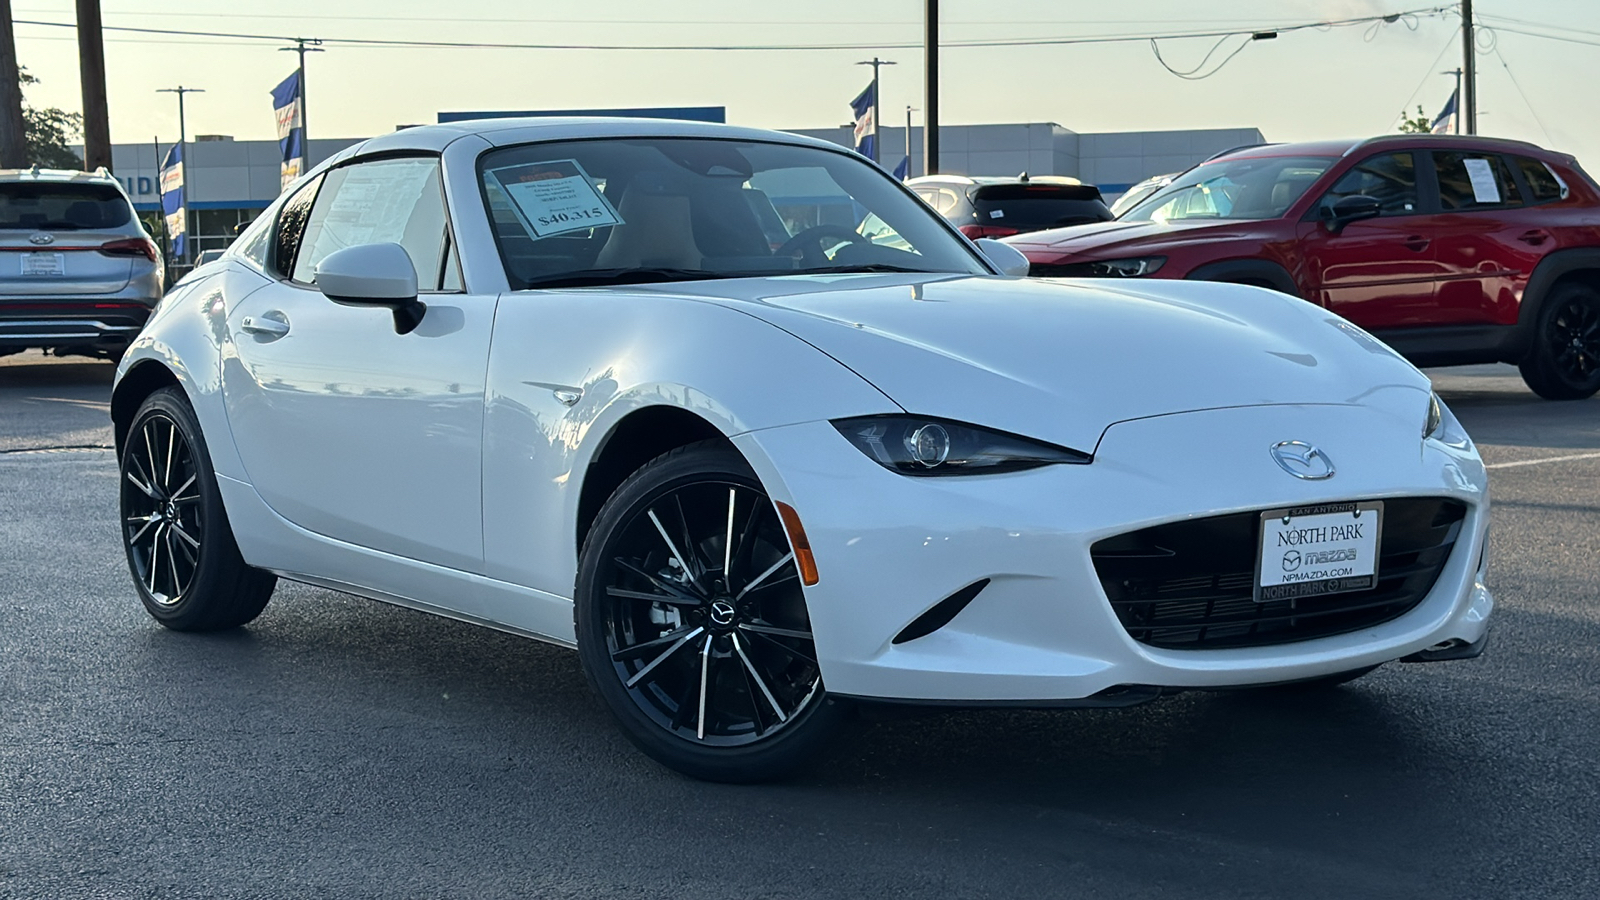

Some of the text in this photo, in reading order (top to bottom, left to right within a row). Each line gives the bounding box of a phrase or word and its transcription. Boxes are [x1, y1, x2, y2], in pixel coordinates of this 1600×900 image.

[538, 207, 603, 227] $40,315
[1291, 504, 1355, 516] SAN ANTONIO
[1278, 523, 1364, 547] NORTH PARK
[1305, 548, 1357, 565] mazda
[1282, 568, 1352, 582] NPMAZDA.COM
[1263, 587, 1296, 599] NORTH
[1300, 583, 1326, 595] PARK
